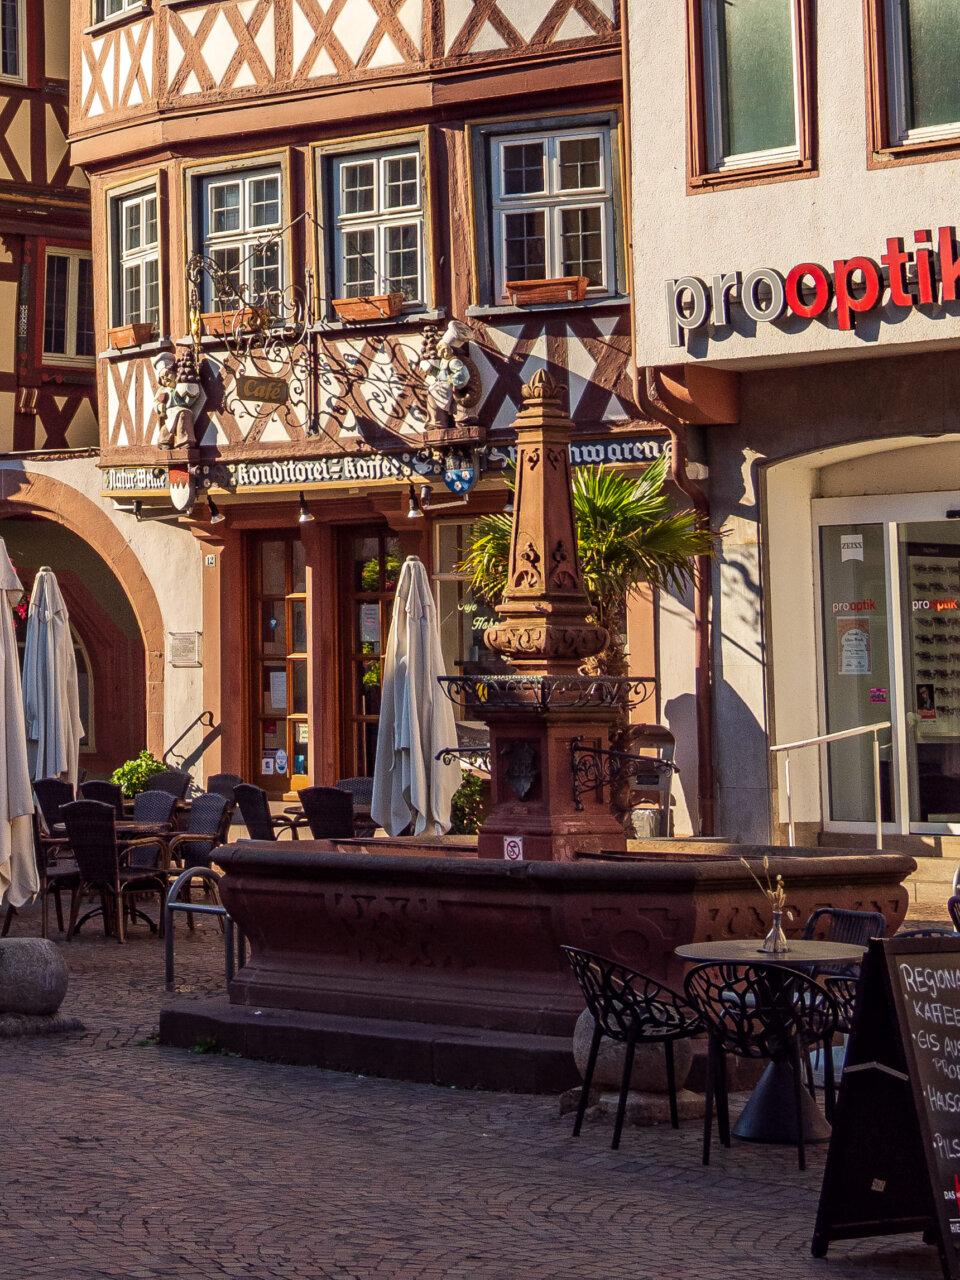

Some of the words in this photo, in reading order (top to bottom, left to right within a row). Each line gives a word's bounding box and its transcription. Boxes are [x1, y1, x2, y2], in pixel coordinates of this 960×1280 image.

[243, 378, 281, 400] Café
[841, 542, 863, 550] ZEISS
[918, 1030, 940, 1051] EIS
